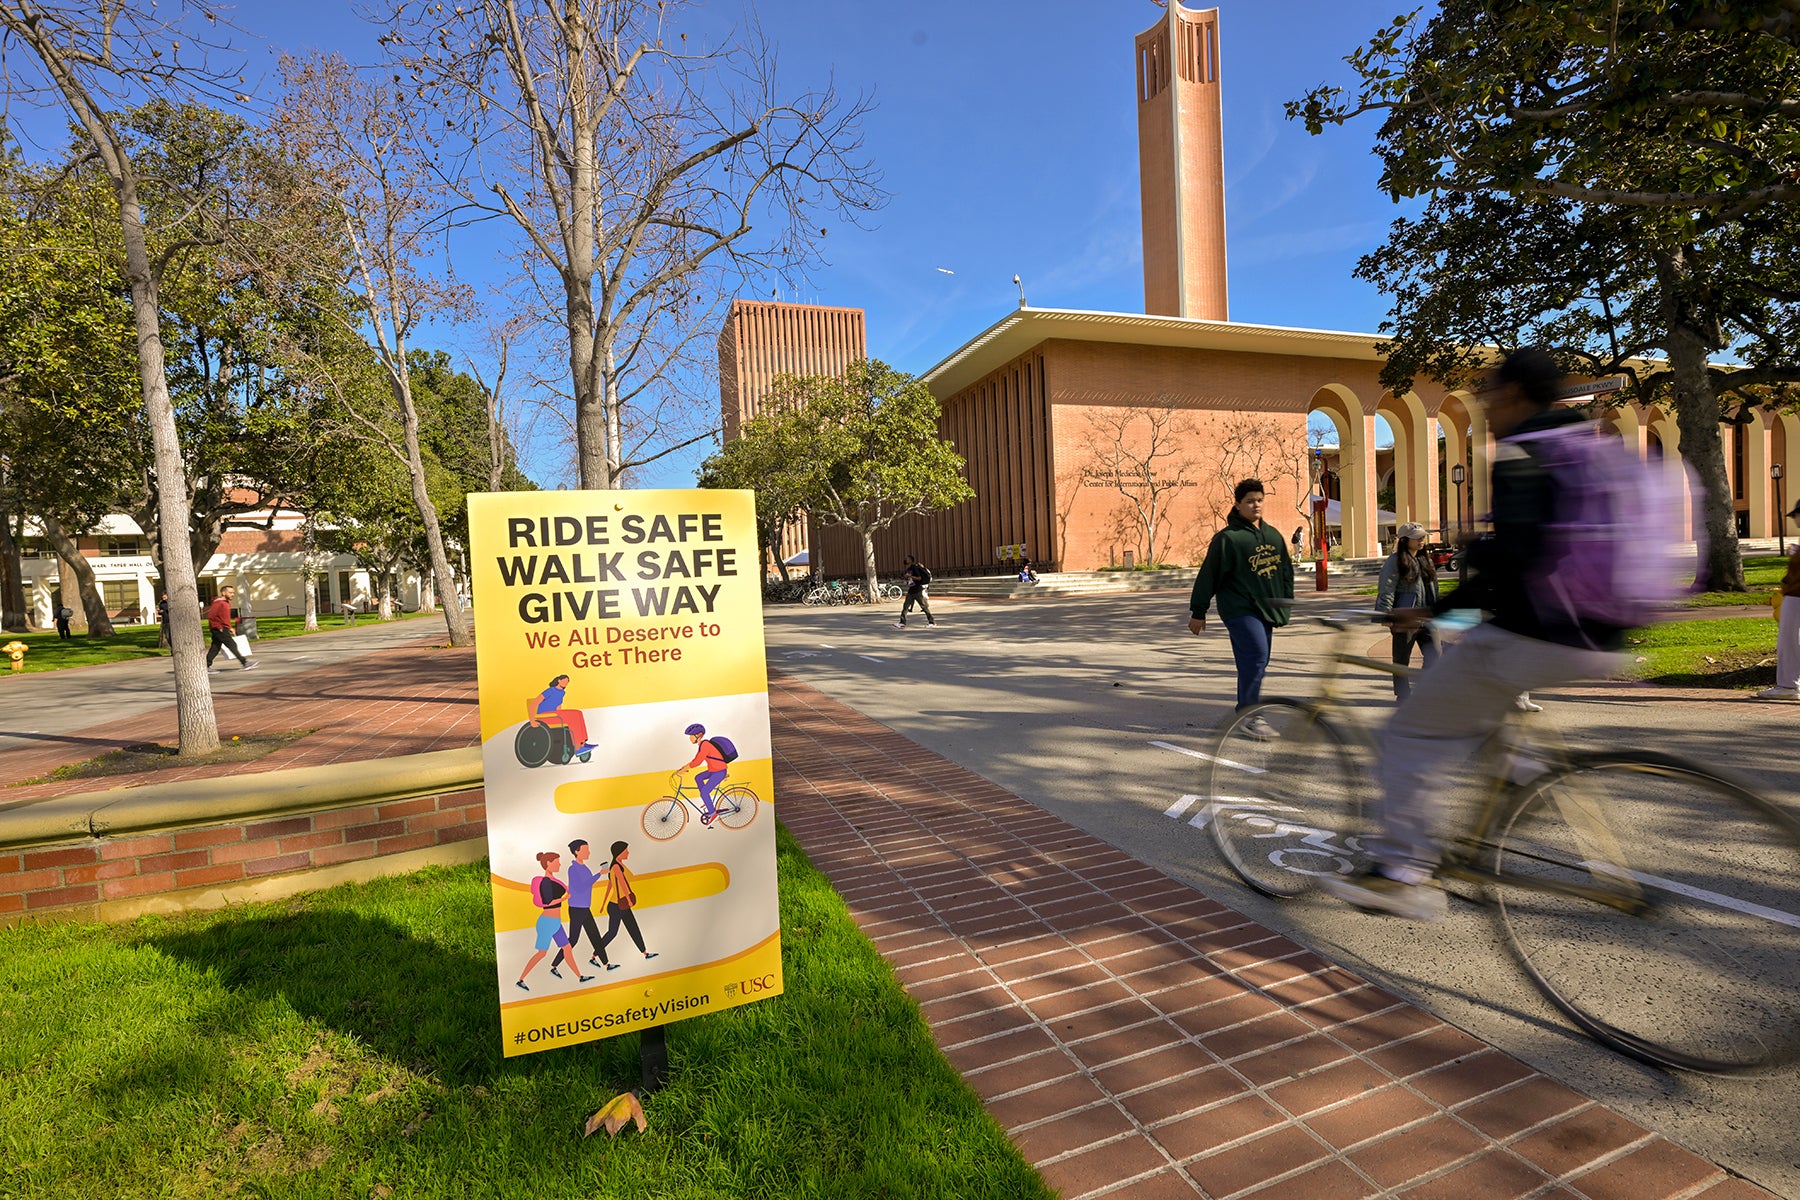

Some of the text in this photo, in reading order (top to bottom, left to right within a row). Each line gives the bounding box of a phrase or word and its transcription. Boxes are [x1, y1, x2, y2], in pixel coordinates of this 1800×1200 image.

[1592, 380, 1614, 391] PKWY
[1095, 469, 1113, 479] Joseph
[1161, 479, 1179, 487] Public
[1180, 479, 1198, 487] Affairs
[508, 513, 724, 548] RIDE SAFE
[1255, 544, 1276, 552] CAMP
[496, 548, 738, 587] WALK SAFE
[518, 584, 722, 624] GIVE WAY
[525, 621, 721, 650] We All Deserve to
[572, 646, 682, 669] Get There
[740, 973, 775, 995] USC
[514, 993, 710, 1045] #ONEUSCSafetyVision
